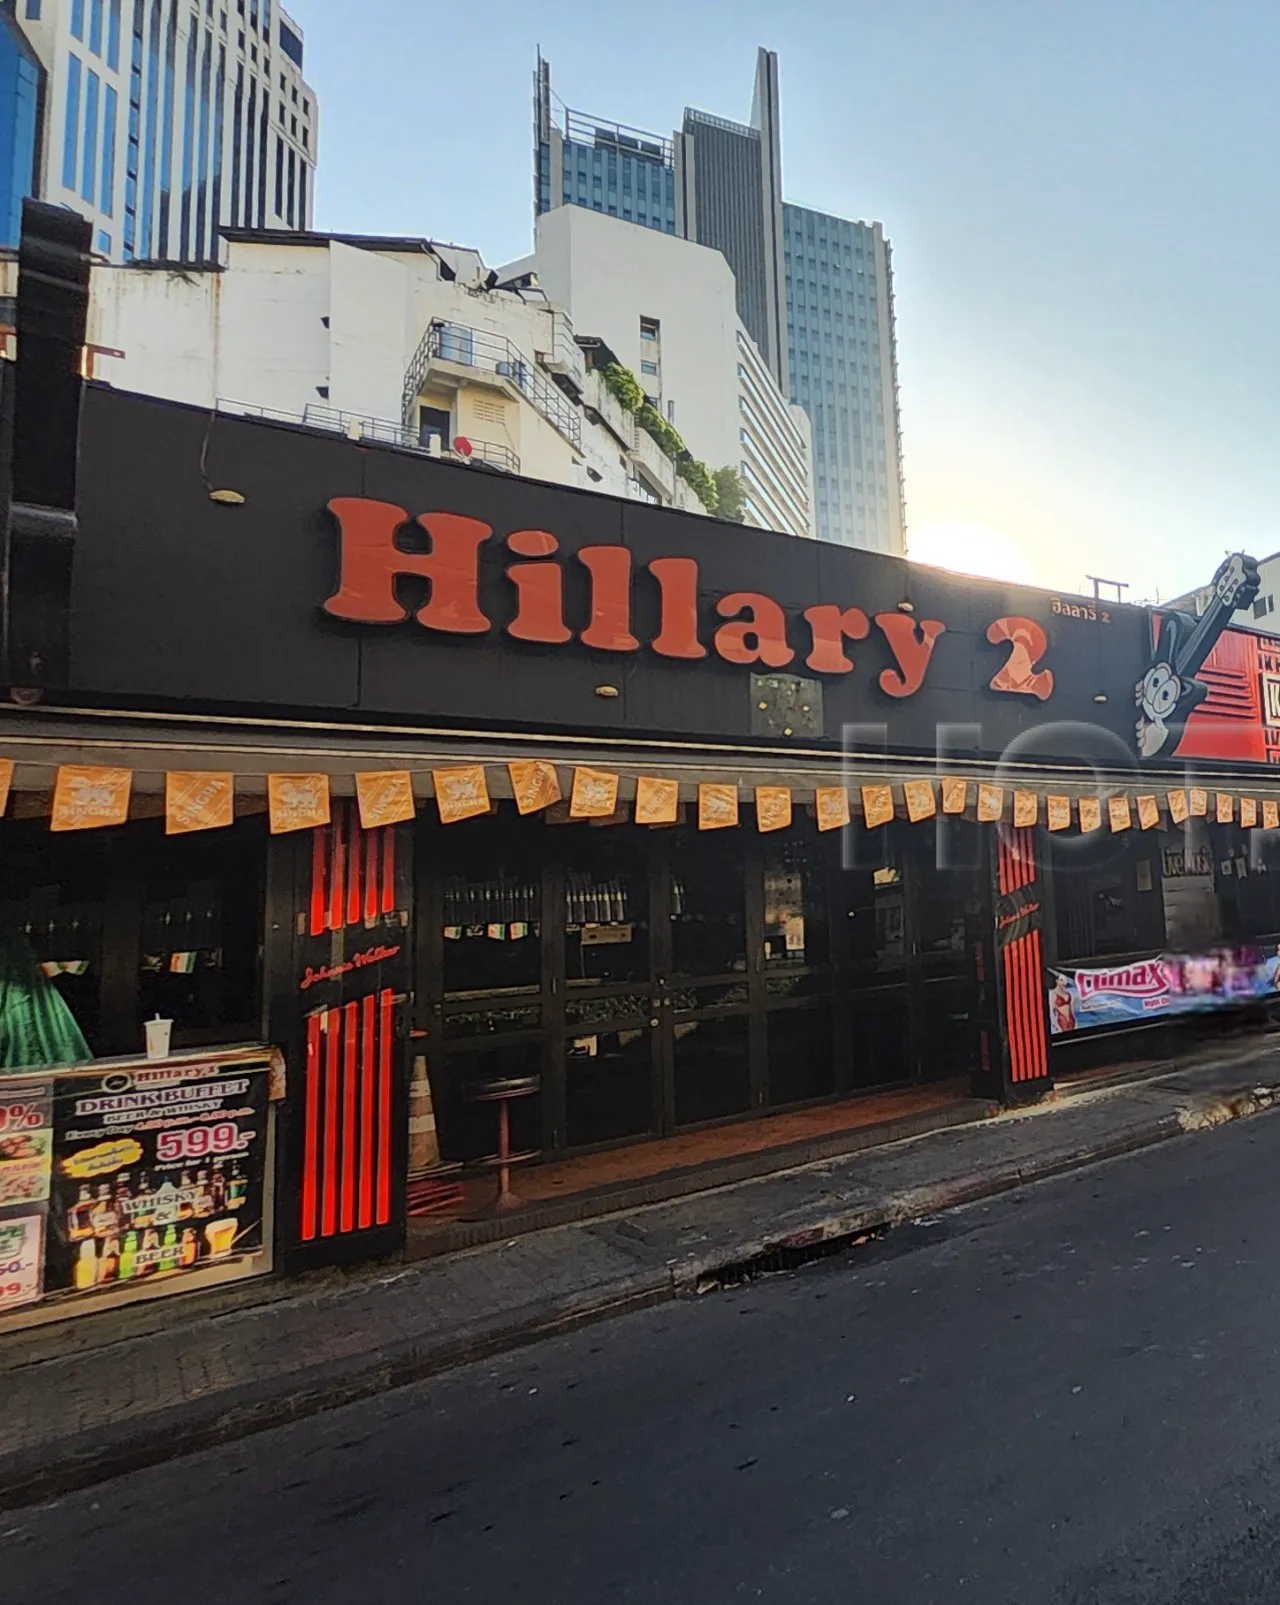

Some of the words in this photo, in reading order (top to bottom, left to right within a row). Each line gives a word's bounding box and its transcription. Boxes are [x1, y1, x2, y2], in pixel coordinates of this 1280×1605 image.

[323, 496, 947, 698] Hillary
[985, 615, 1055, 701] 2
[1101, 611, 1111, 624] 2
[176, 778, 226, 826] SINGHA
[367, 778, 406, 822] SINGHA
[80, 1093, 160, 1113] DRINK
[165, 1080, 247, 1100] BUFFET
[125, 1190, 198, 1212] WHISKY
[156, 1210, 170, 1221] &
[136, 1247, 184, 1265] BEER
